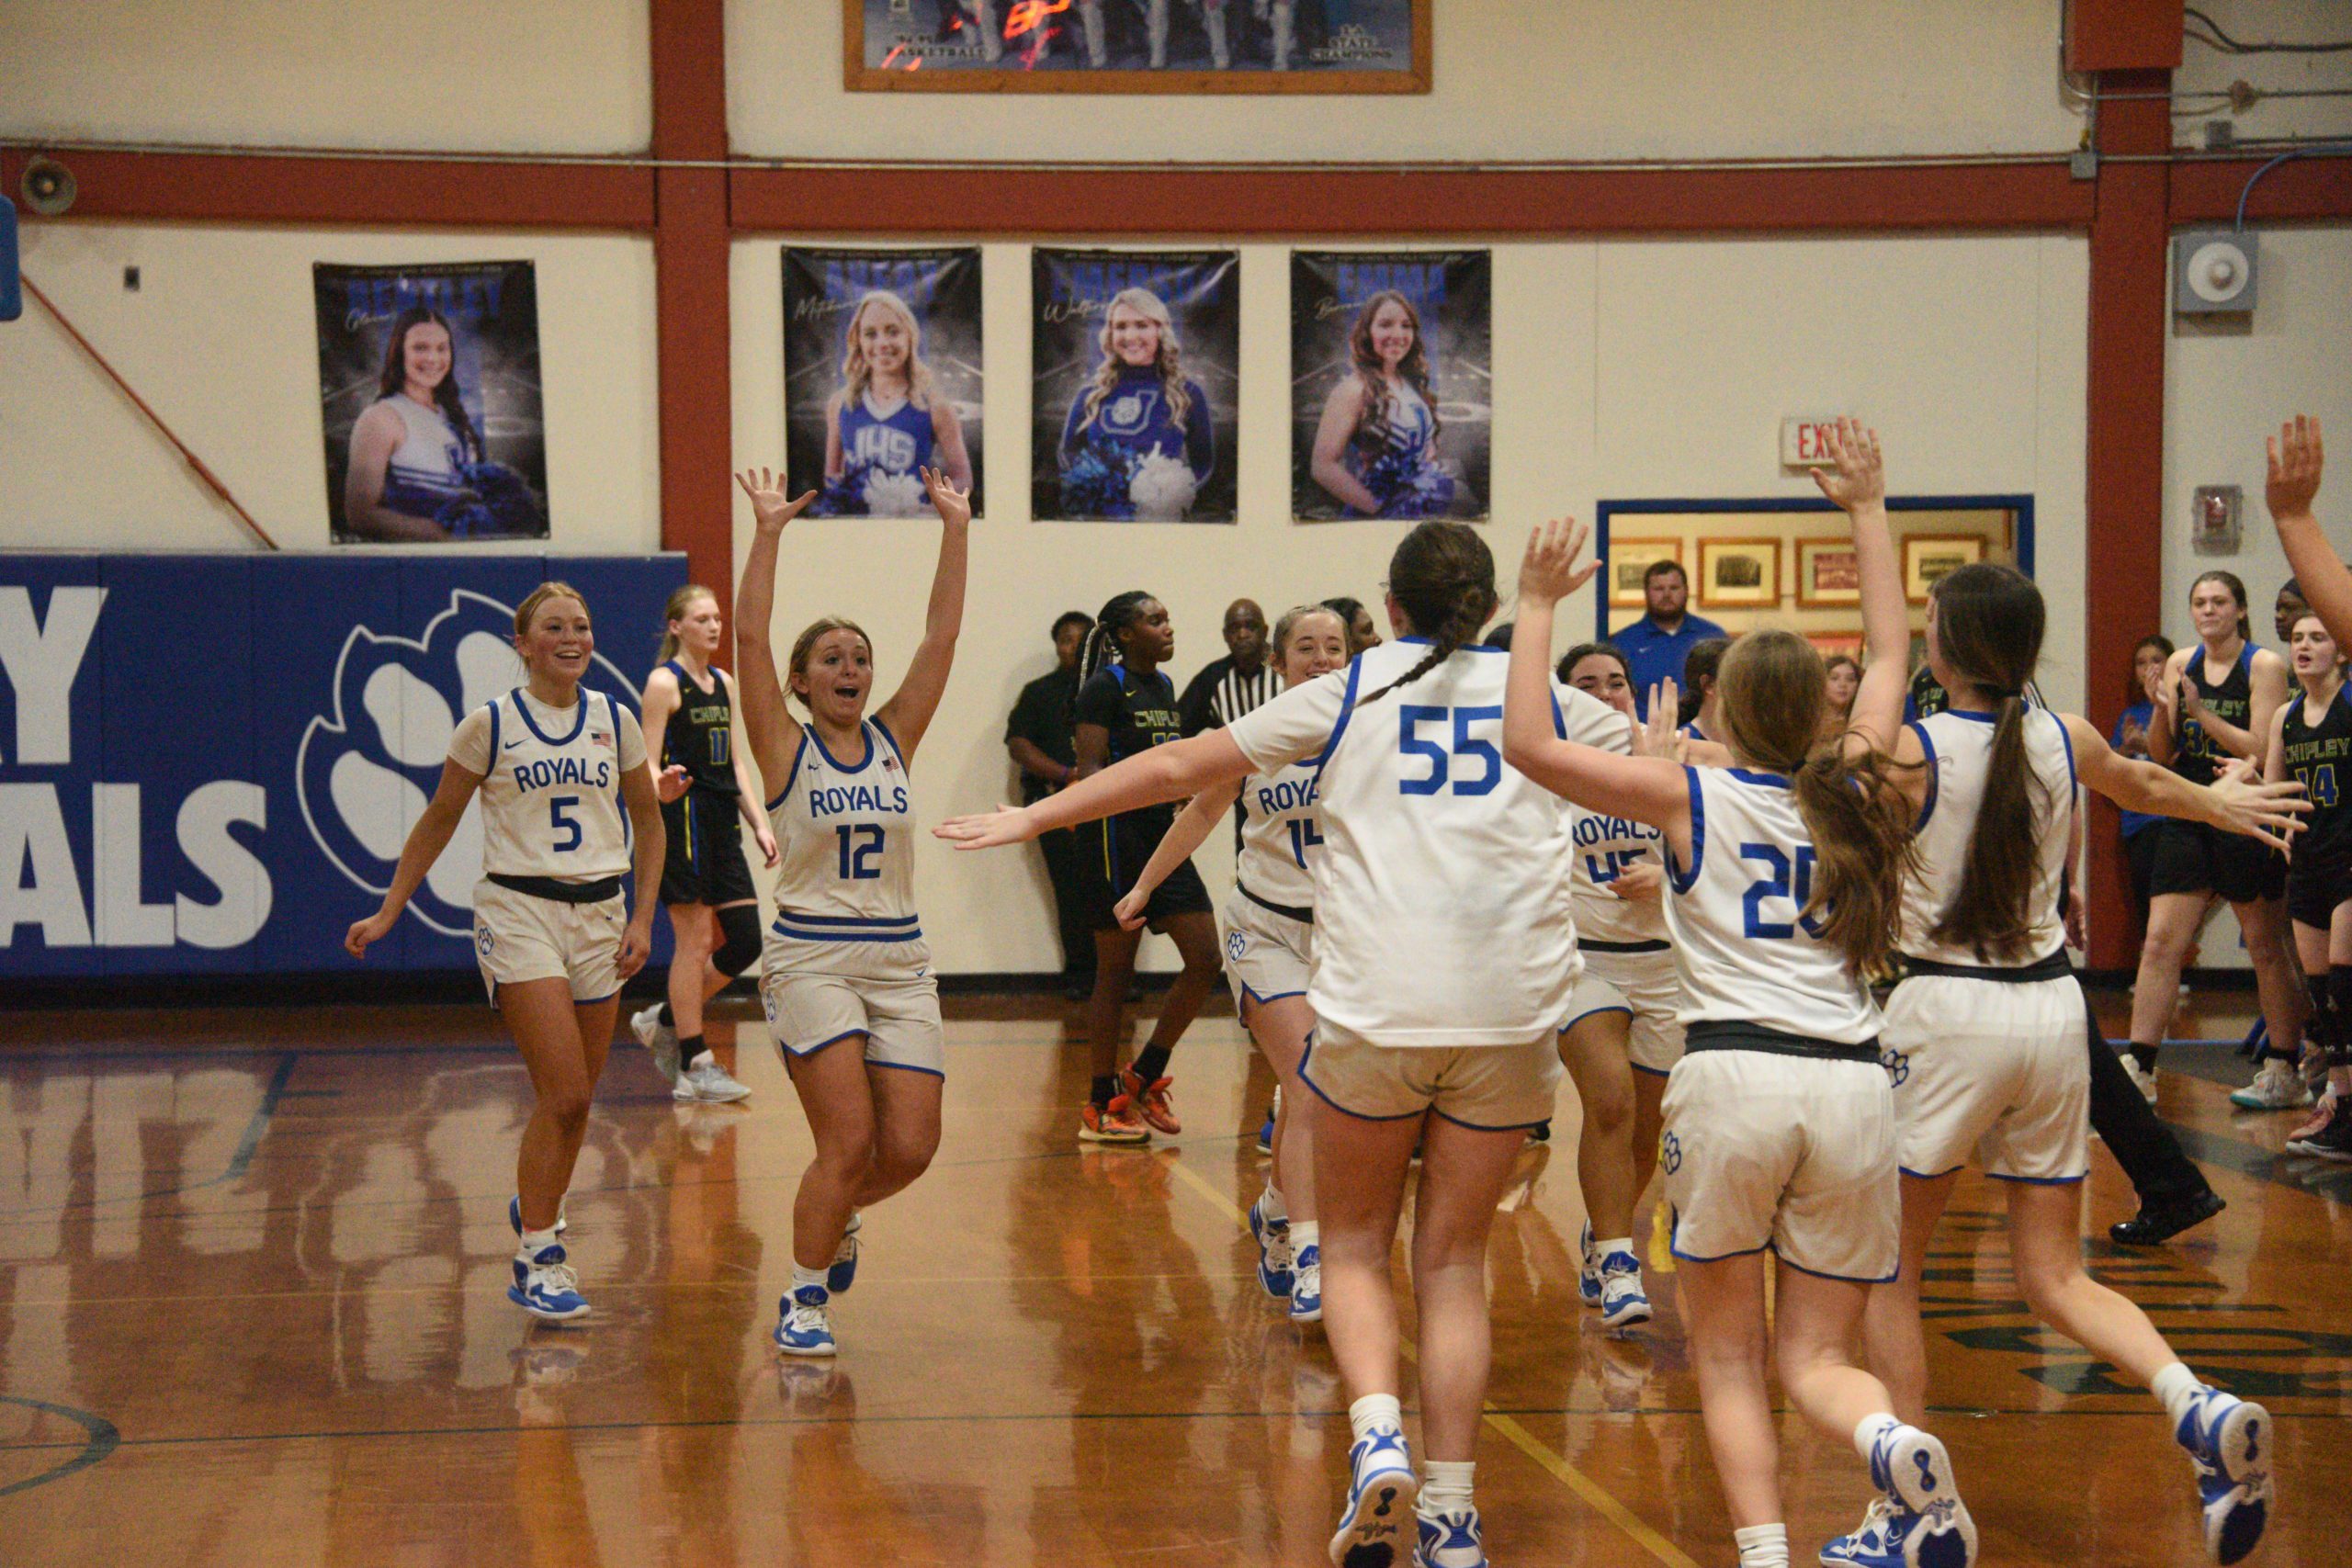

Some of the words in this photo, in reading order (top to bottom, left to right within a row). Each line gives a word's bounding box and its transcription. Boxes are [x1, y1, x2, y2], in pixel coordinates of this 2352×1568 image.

[0, 586, 108, 764] Y
[514, 758, 609, 793] ROYALS
[1399, 705, 1502, 795] 55
[2286, 738, 2350, 764] CHIPLEY
[550, 796, 582, 852] 5
[809, 785, 908, 818] ROYALS
[836, 823, 885, 879] 12
